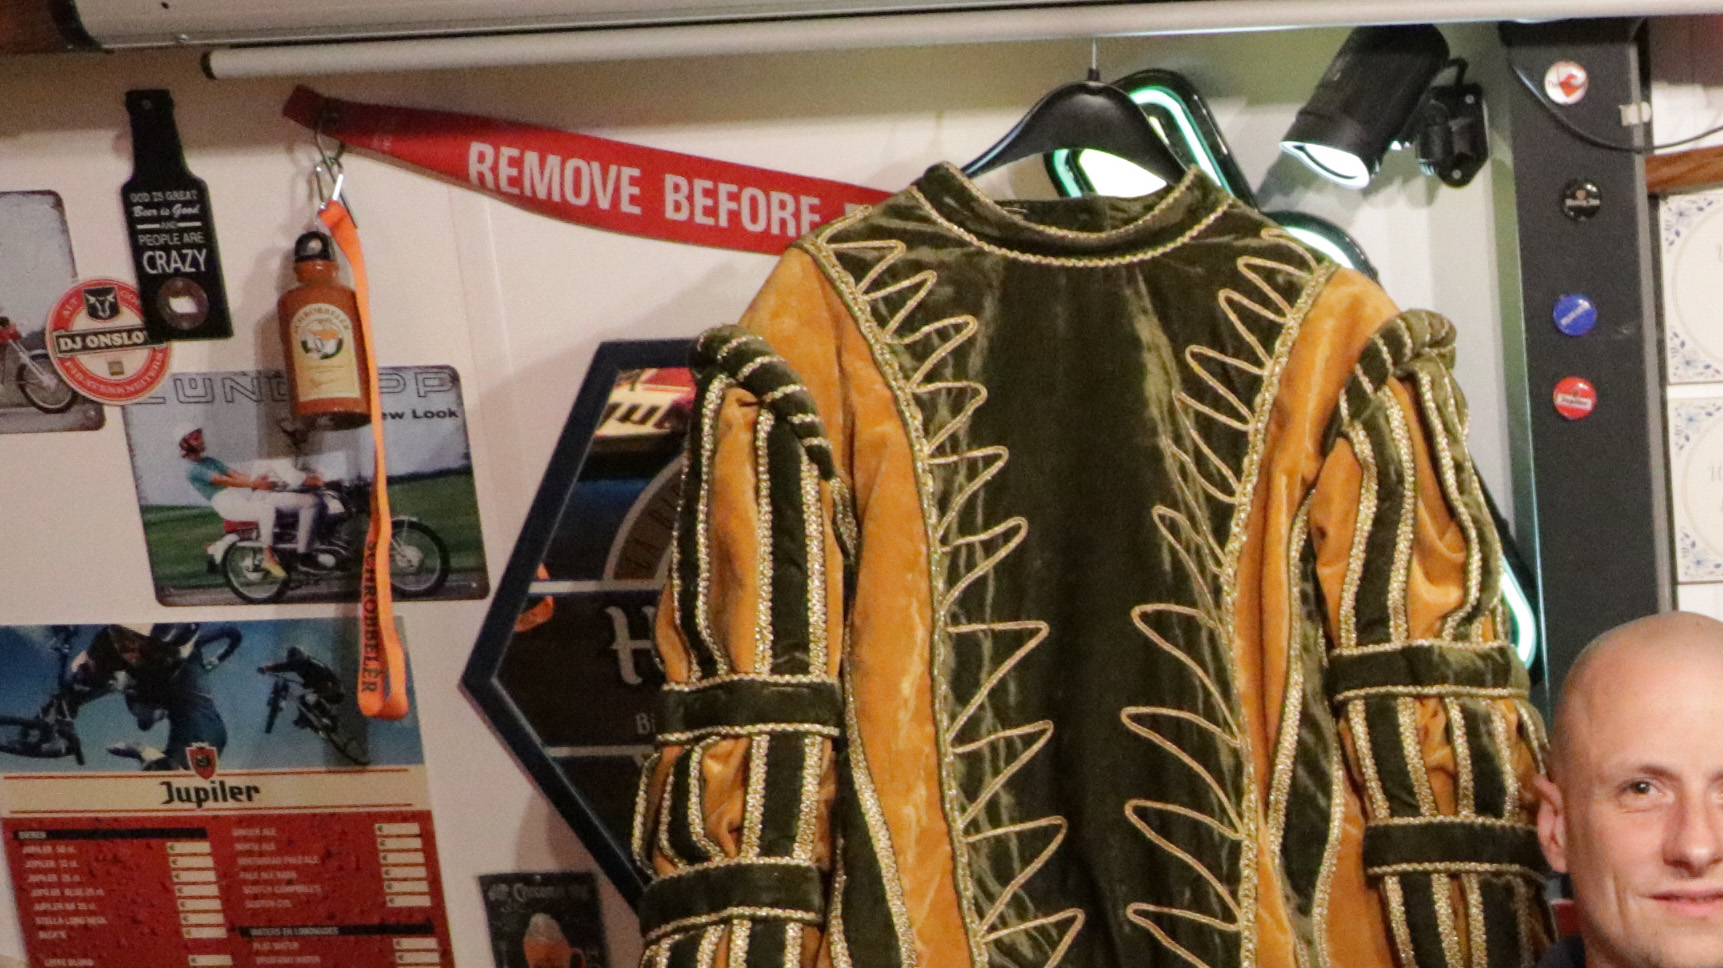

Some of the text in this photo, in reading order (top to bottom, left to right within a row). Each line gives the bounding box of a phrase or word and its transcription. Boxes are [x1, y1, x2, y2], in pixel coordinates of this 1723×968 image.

[130, 190, 198, 202] GOD IS GREAT
[467, 140, 821, 239] REMOVE BEFORE
[133, 205, 158, 217] Beer
[172, 203, 201, 218] Good
[138, 232, 206, 246] PEOPLE ARE
[142, 248, 207, 275] CRAZY
[59, 336, 82, 351] DJ
[412, 407, 458, 420] Look
[160, 780, 261, 809] Jupiler
